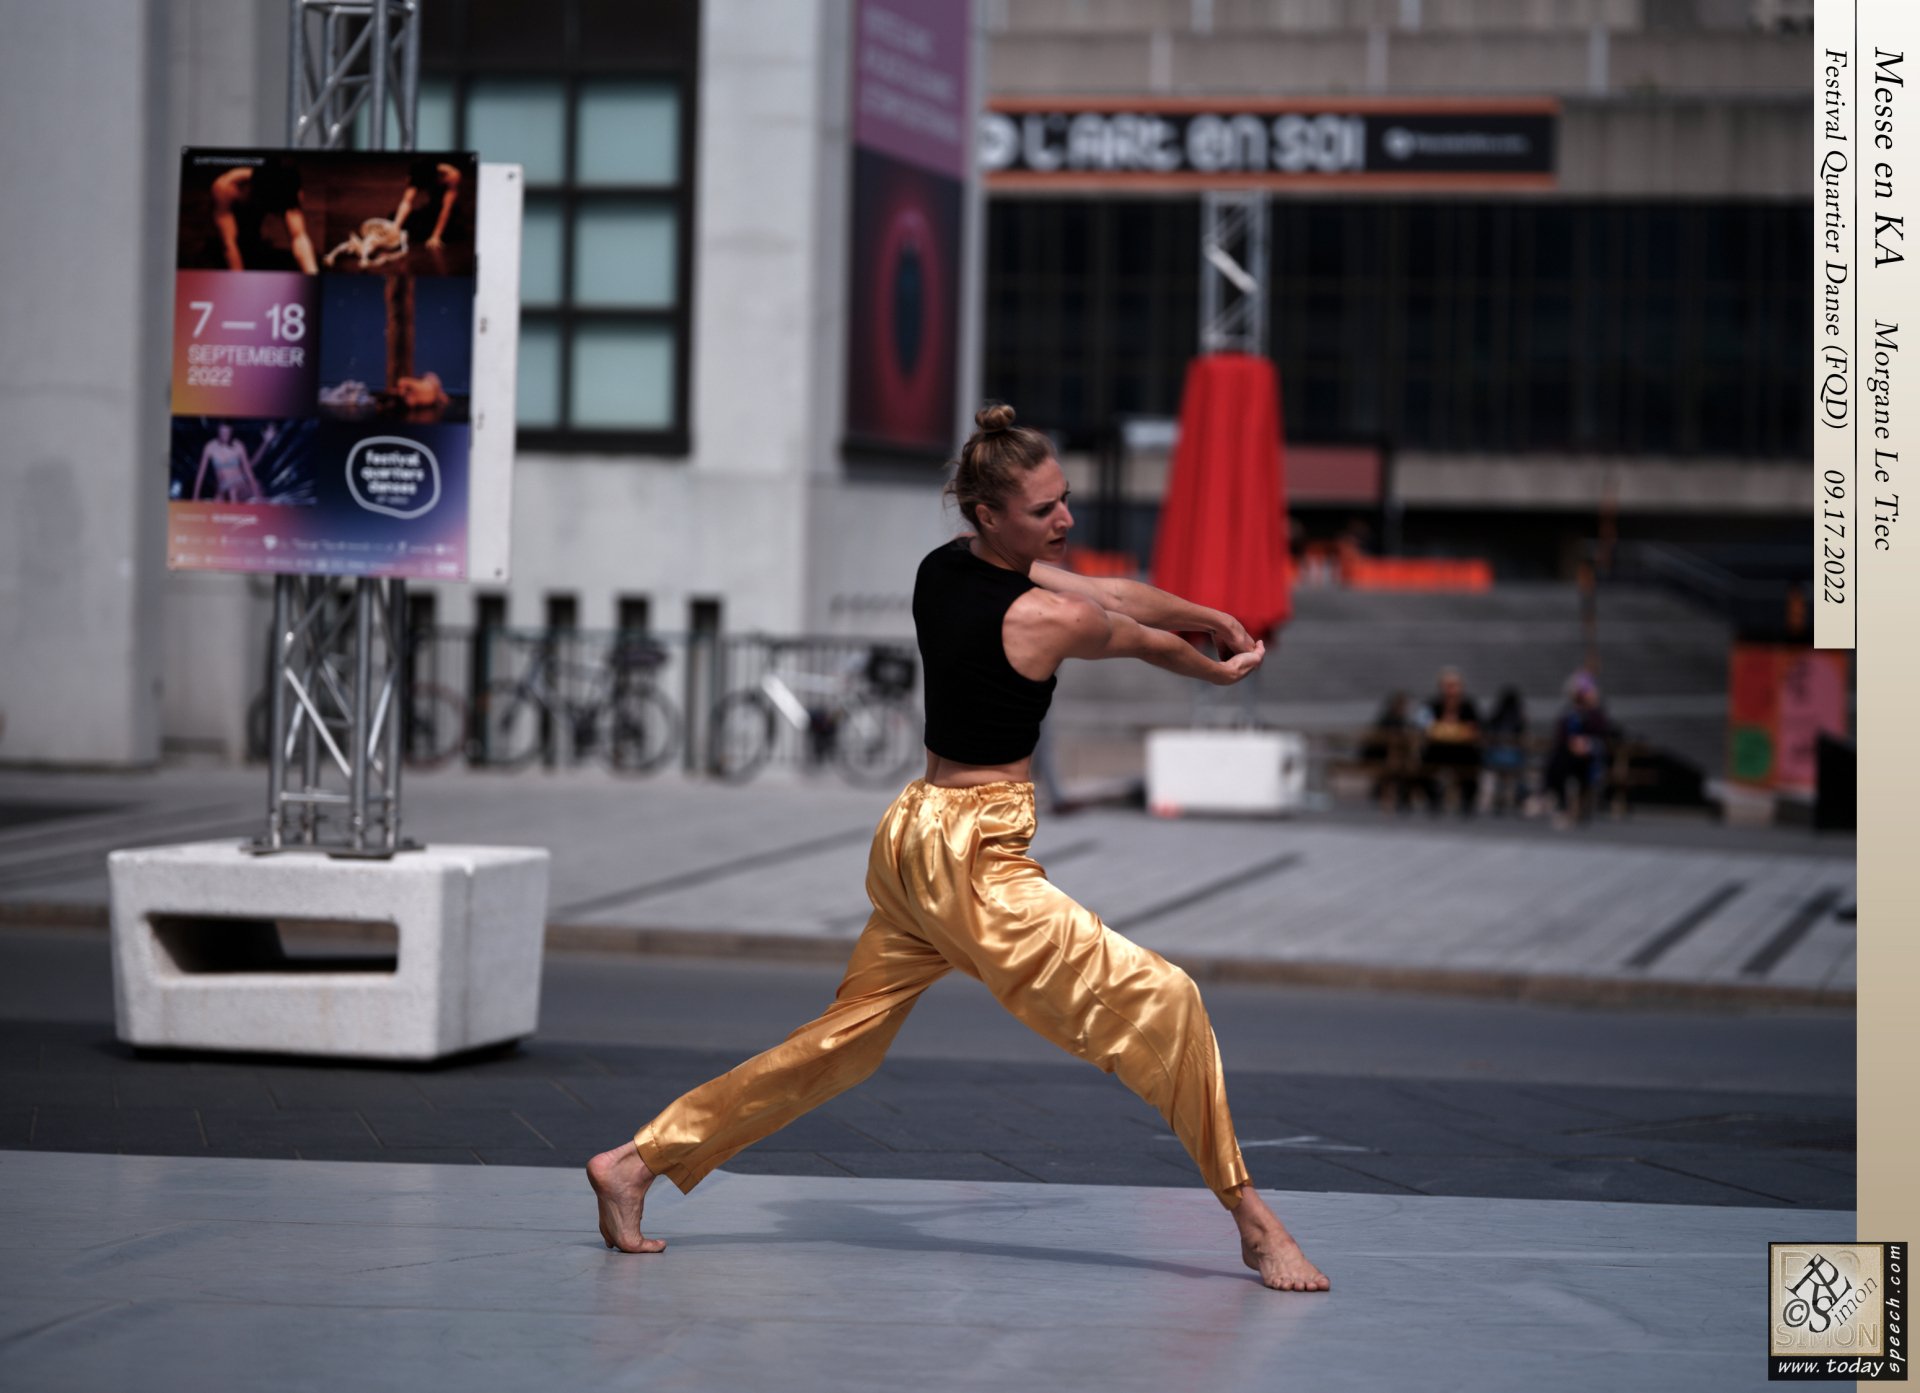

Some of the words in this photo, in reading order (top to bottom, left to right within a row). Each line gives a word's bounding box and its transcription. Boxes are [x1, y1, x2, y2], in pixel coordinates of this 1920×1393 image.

[189, 301, 214, 338] 7
[264, 303, 306, 342] 18
[187, 343, 305, 368] SEPTEMBER
[187, 365, 234, 387] 2022
